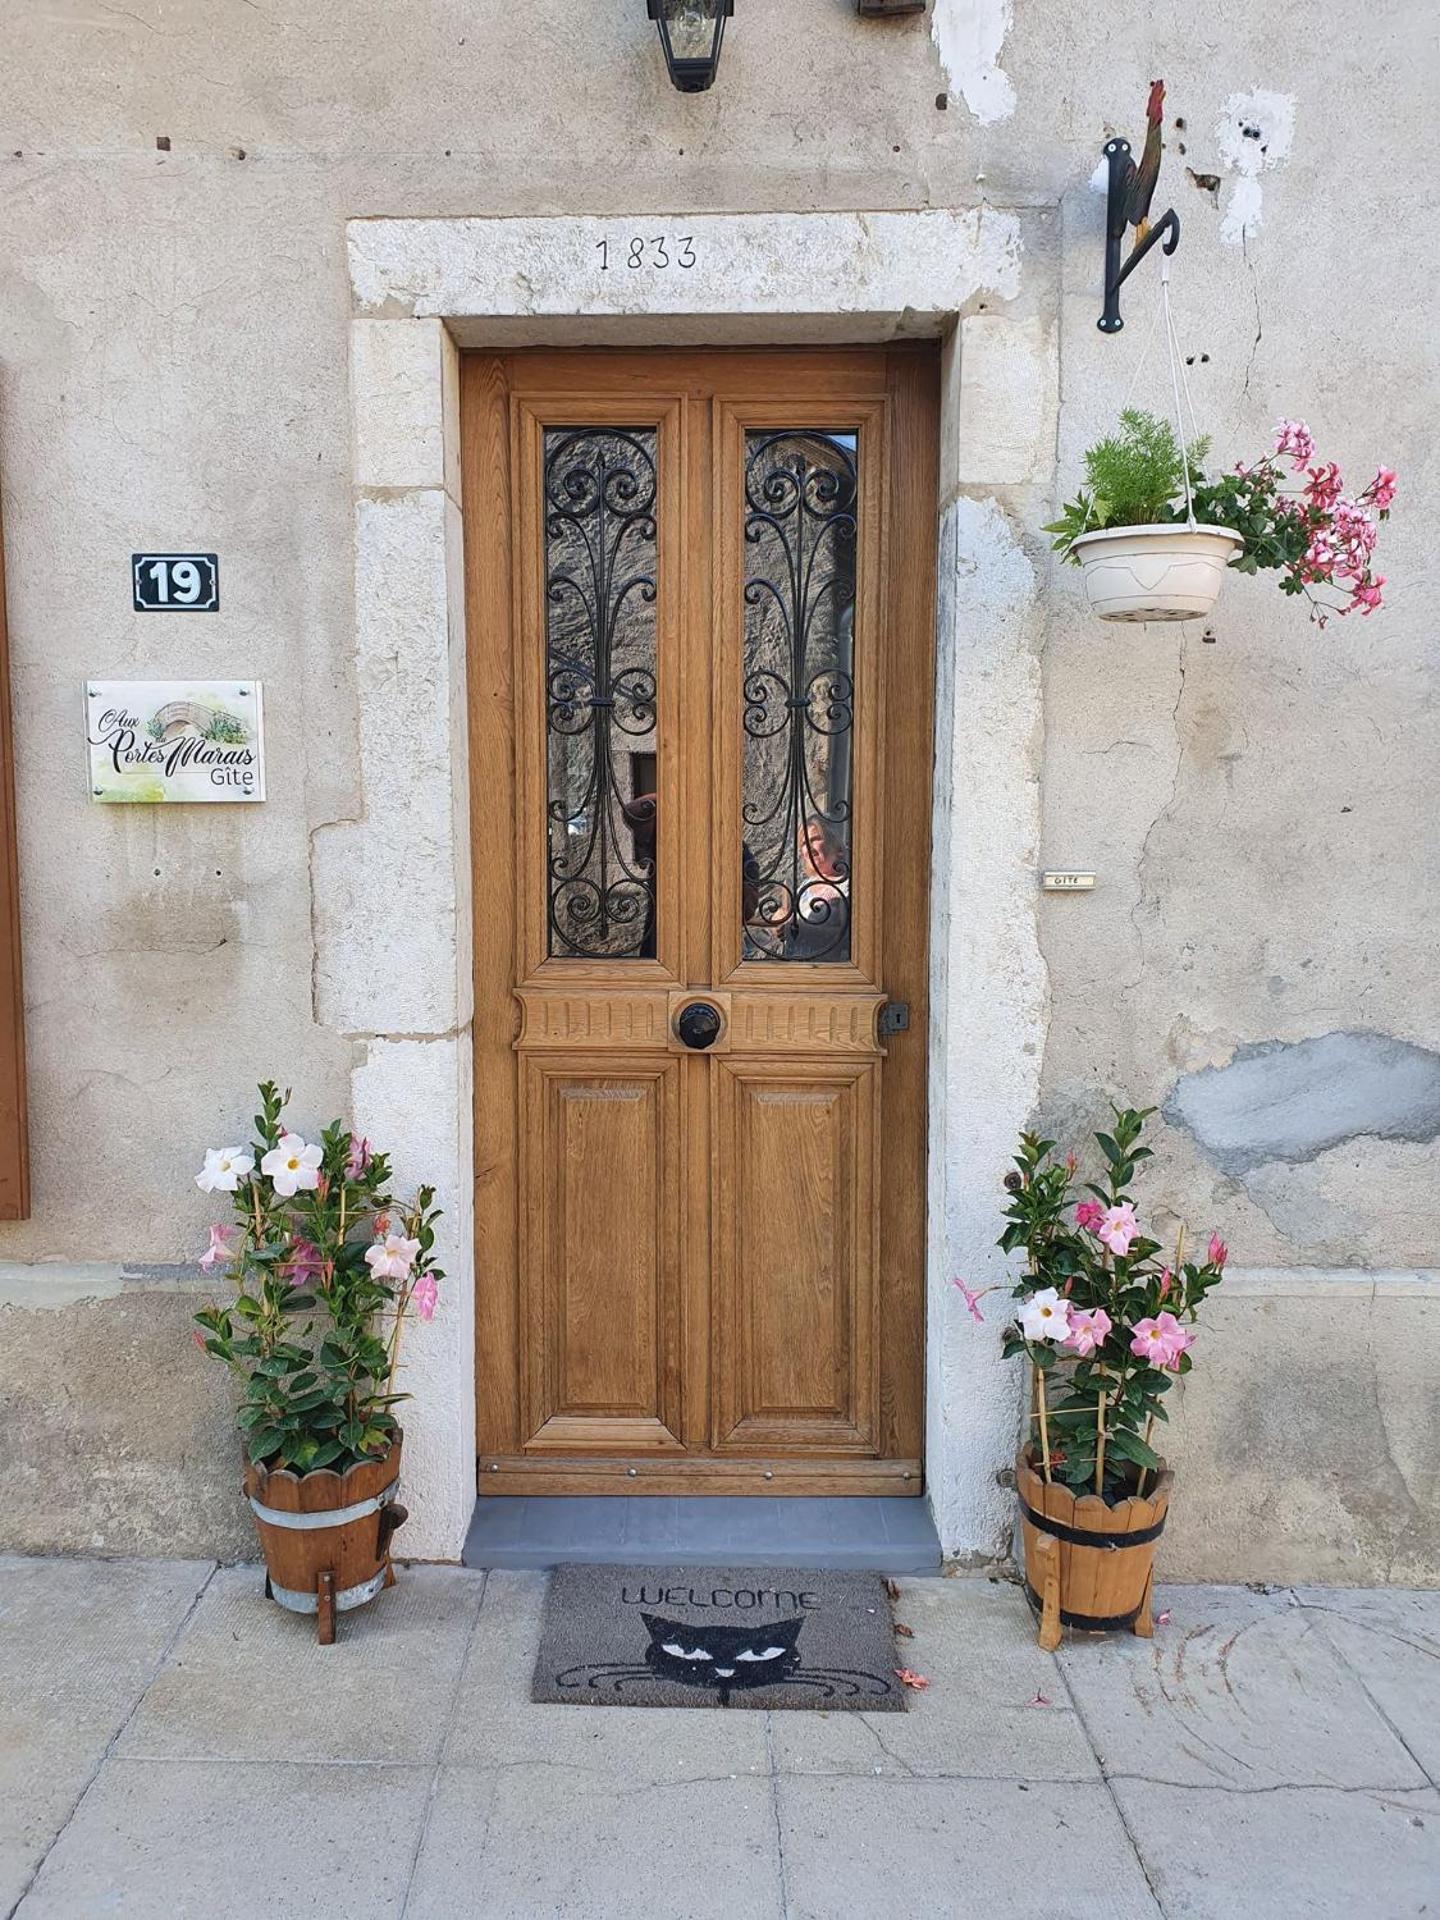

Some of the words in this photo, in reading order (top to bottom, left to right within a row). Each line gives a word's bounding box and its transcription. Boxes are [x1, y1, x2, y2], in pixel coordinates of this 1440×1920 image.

[596, 236, 697, 271] 1833
[149, 561, 203, 604] 19
[98, 708, 140, 733] Aux
[87, 728, 166, 774] Portes
[151, 735, 257, 778] Marais
[210, 766, 254, 786] Gîte
